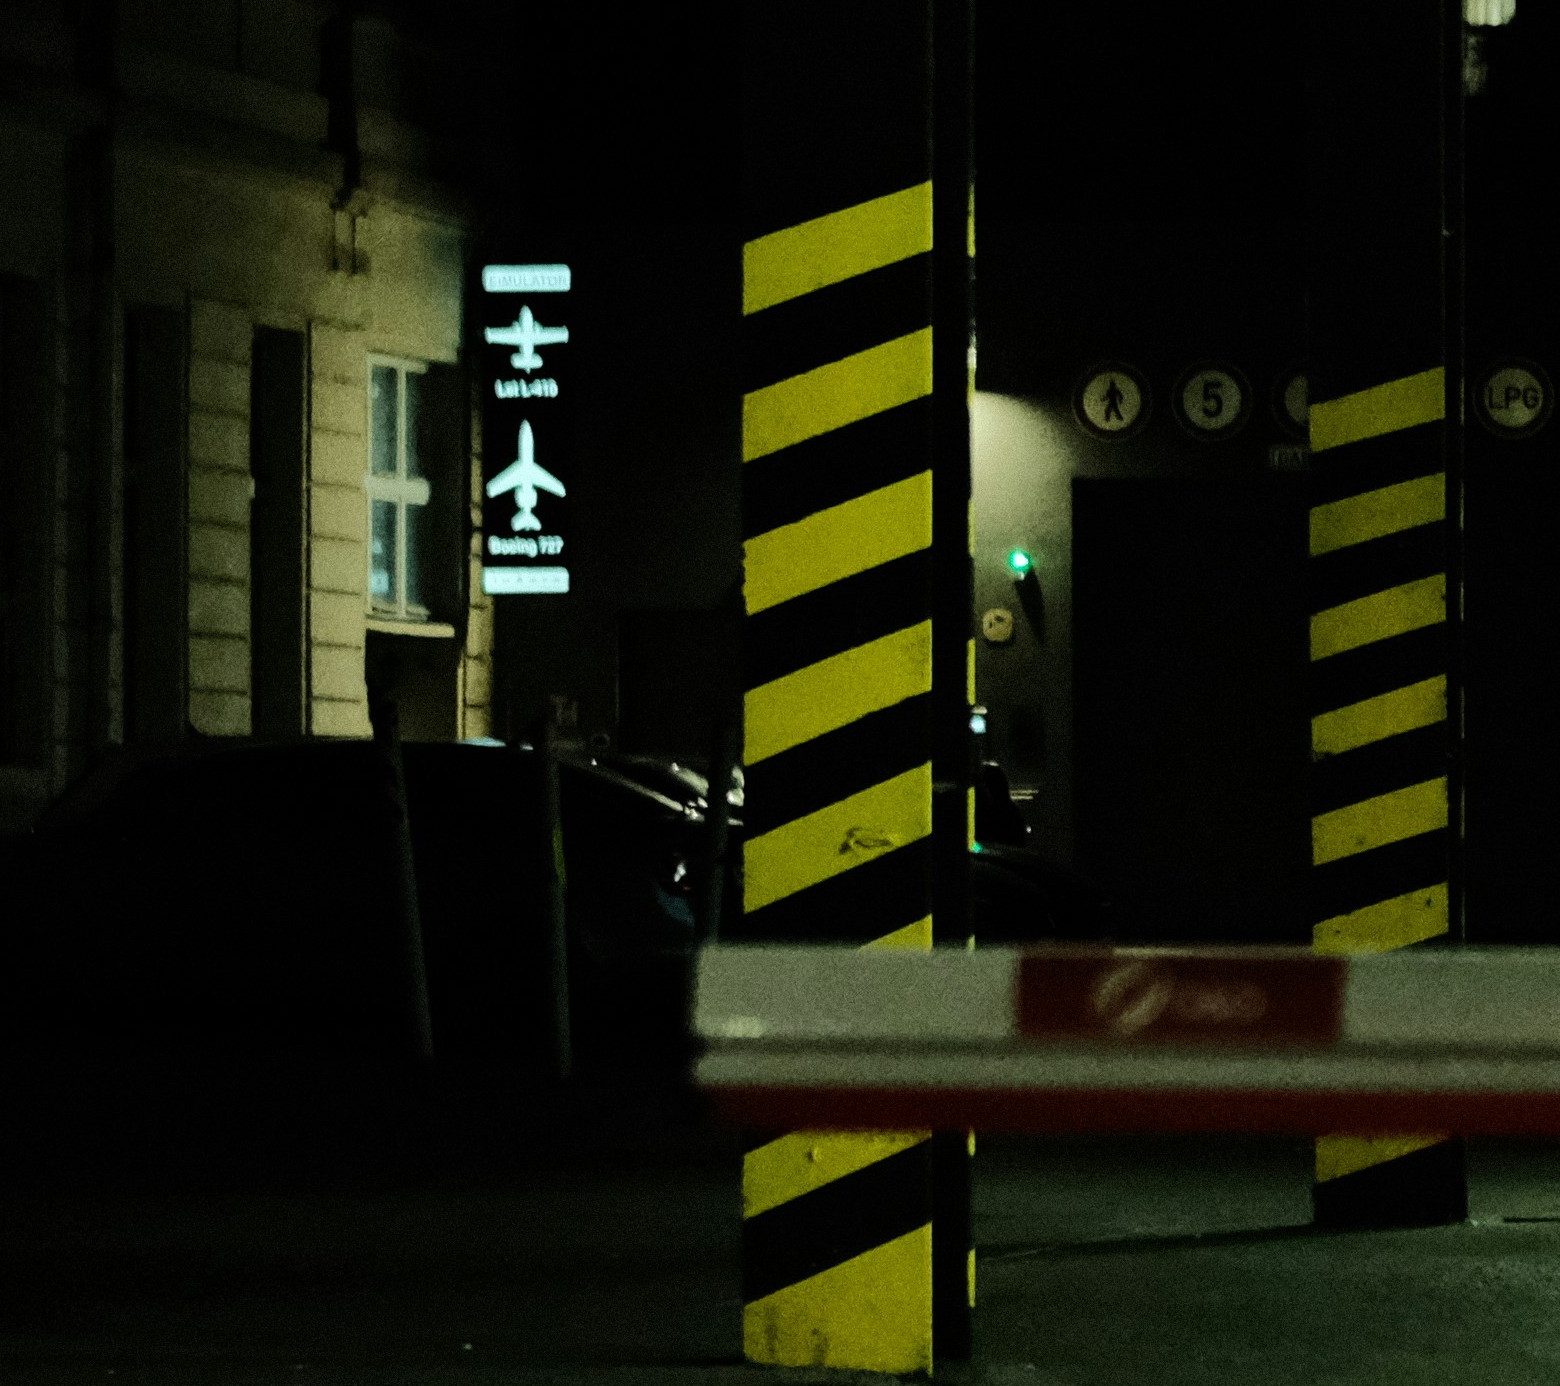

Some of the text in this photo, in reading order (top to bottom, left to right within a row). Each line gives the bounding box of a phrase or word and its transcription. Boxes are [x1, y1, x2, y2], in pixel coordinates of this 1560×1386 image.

[487, 274, 568, 288] SIMULATOR
[1202, 381, 1223, 417] 5
[1488, 385, 1539, 409] LPG
[488, 535, 538, 558] Boeing
